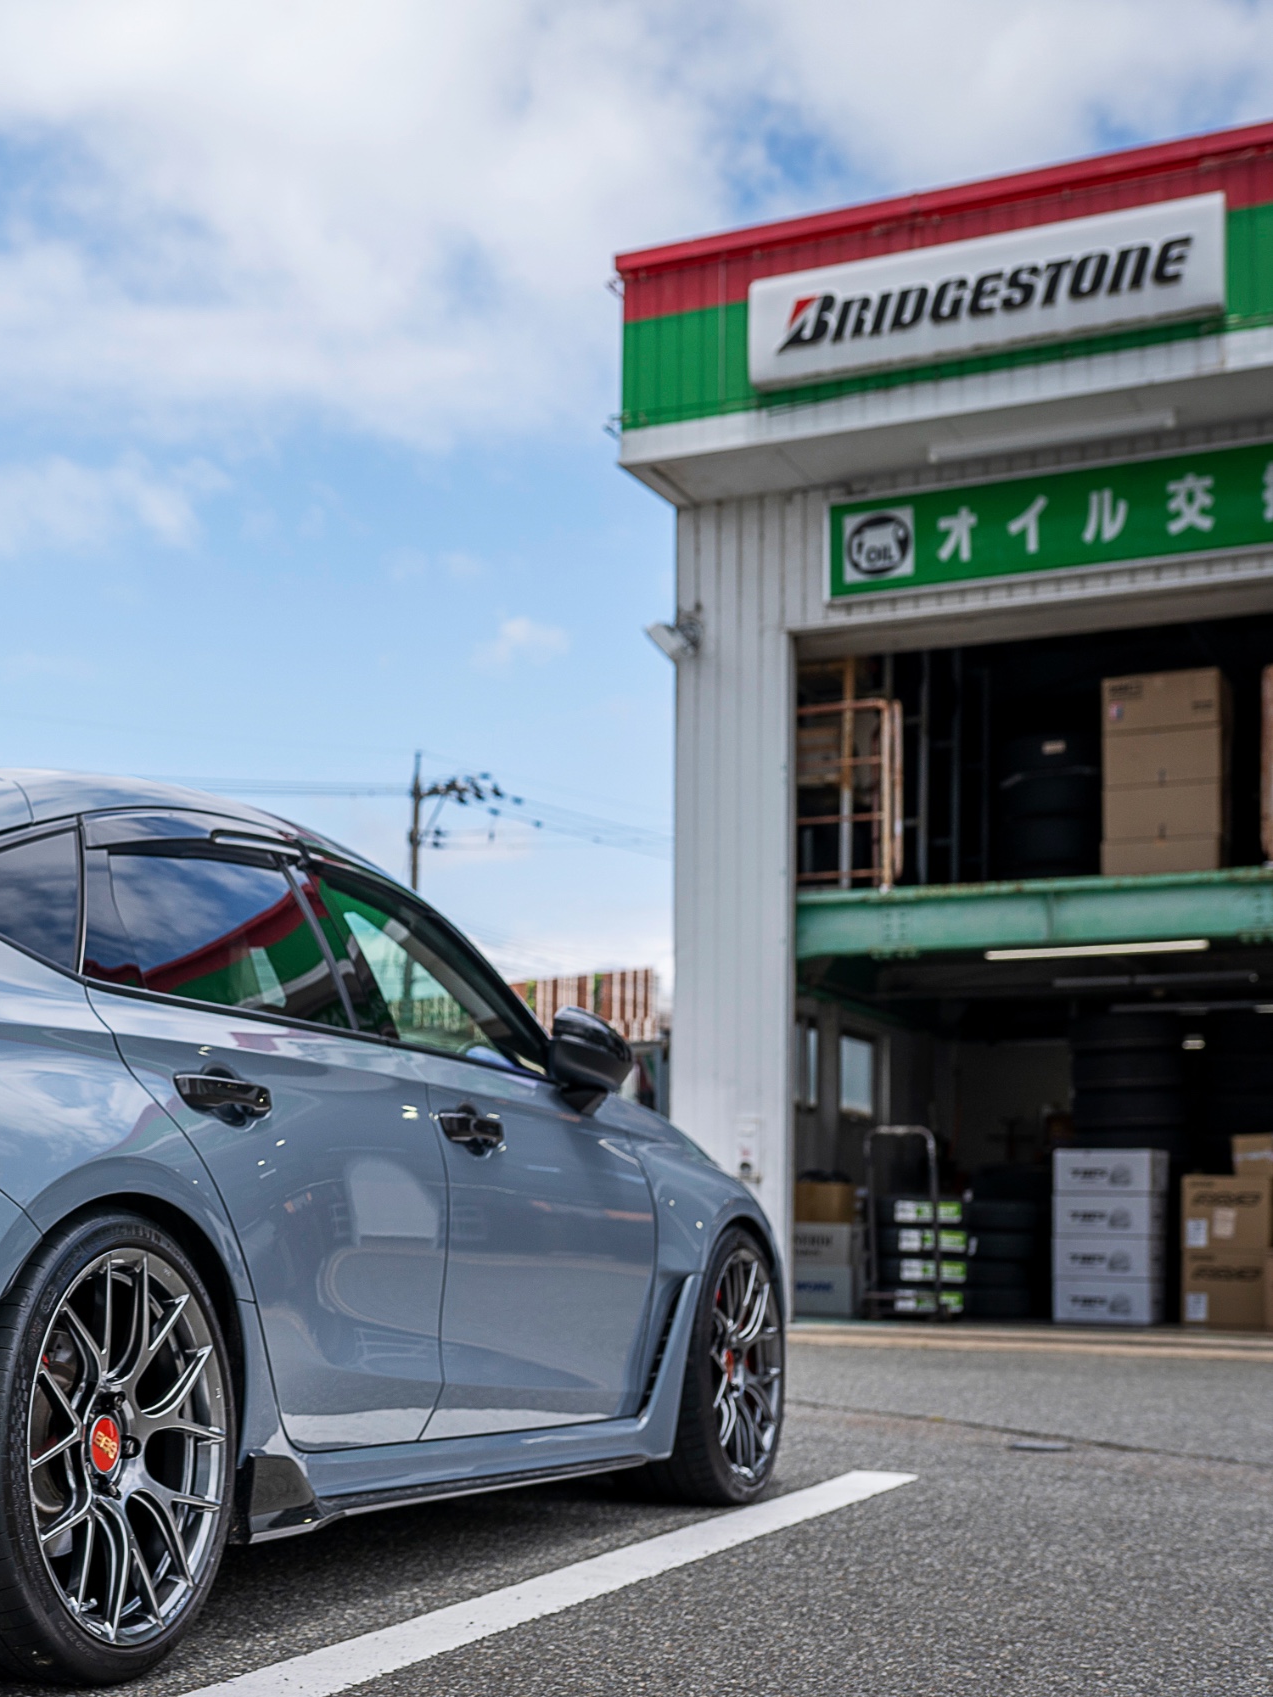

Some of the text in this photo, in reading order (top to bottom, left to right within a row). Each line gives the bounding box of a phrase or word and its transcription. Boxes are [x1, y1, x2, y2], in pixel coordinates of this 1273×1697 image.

[778, 234, 1193, 354] BRIDGESTONE
[937, 460, 1273, 562] オイル交
[866, 544, 894, 563] OIL
[94, 1430, 118, 1459] BBS
